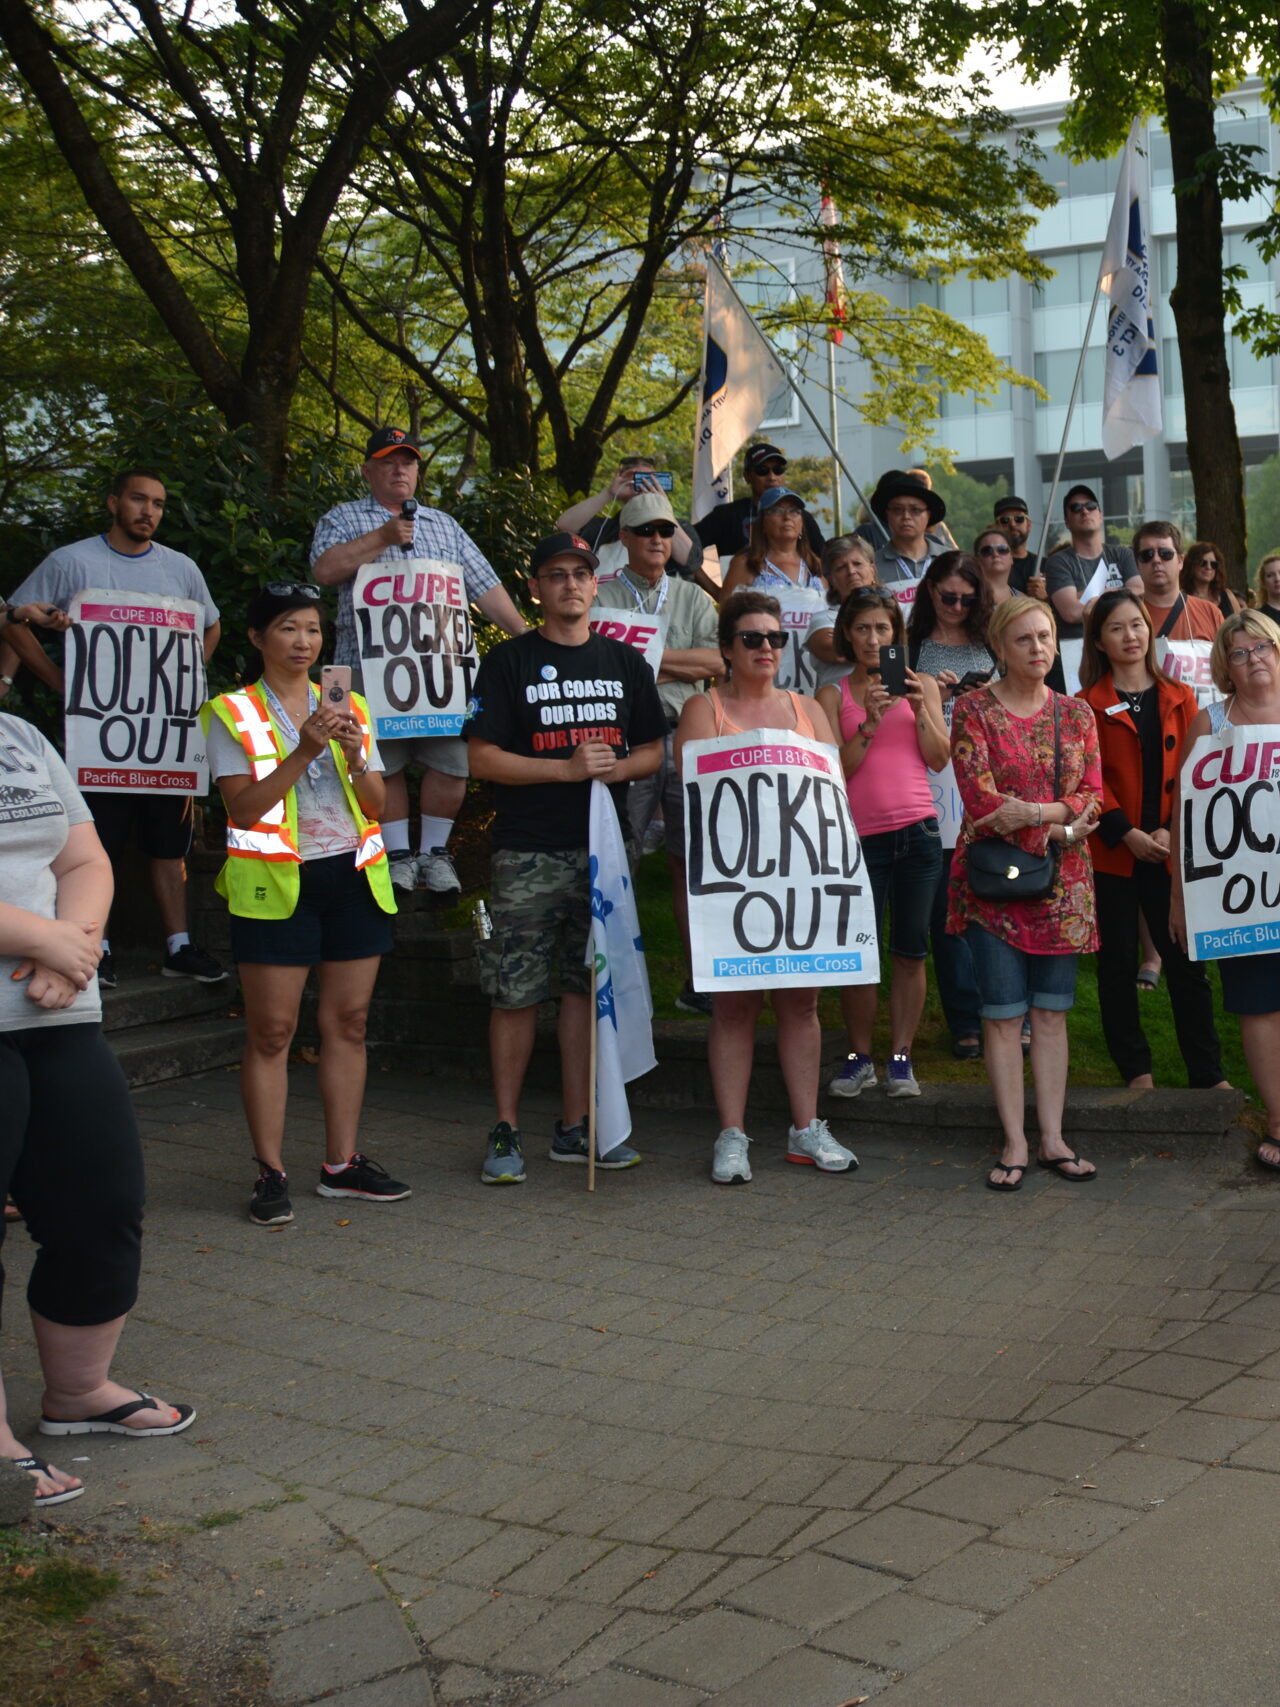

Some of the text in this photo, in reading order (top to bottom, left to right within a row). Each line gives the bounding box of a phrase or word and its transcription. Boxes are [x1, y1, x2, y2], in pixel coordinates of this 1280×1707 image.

[363, 573, 461, 606] CUPE
[110, 608, 175, 624] CUPE 1816
[356, 602, 474, 658] LOCKED
[65, 623, 208, 720] LOCKED
[383, 655, 476, 711] OUT
[525, 679, 624, 703] OUR COASTS
[384, 718, 425, 731] Pacific
[428, 716, 453, 729] Blue
[540, 702, 617, 725] OUR JOBS
[99, 715, 196, 764] OUT
[532, 730, 568, 752] OUR
[730, 749, 810, 767] CUPE 1816
[83, 771, 192, 788] Pacific Blue Cross,
[685, 772, 861, 896] LOCKED
[733, 883, 863, 954] OUT
[1203, 930, 1251, 949] Pacific
[719, 956, 857, 976] Pacific Blue Cross
